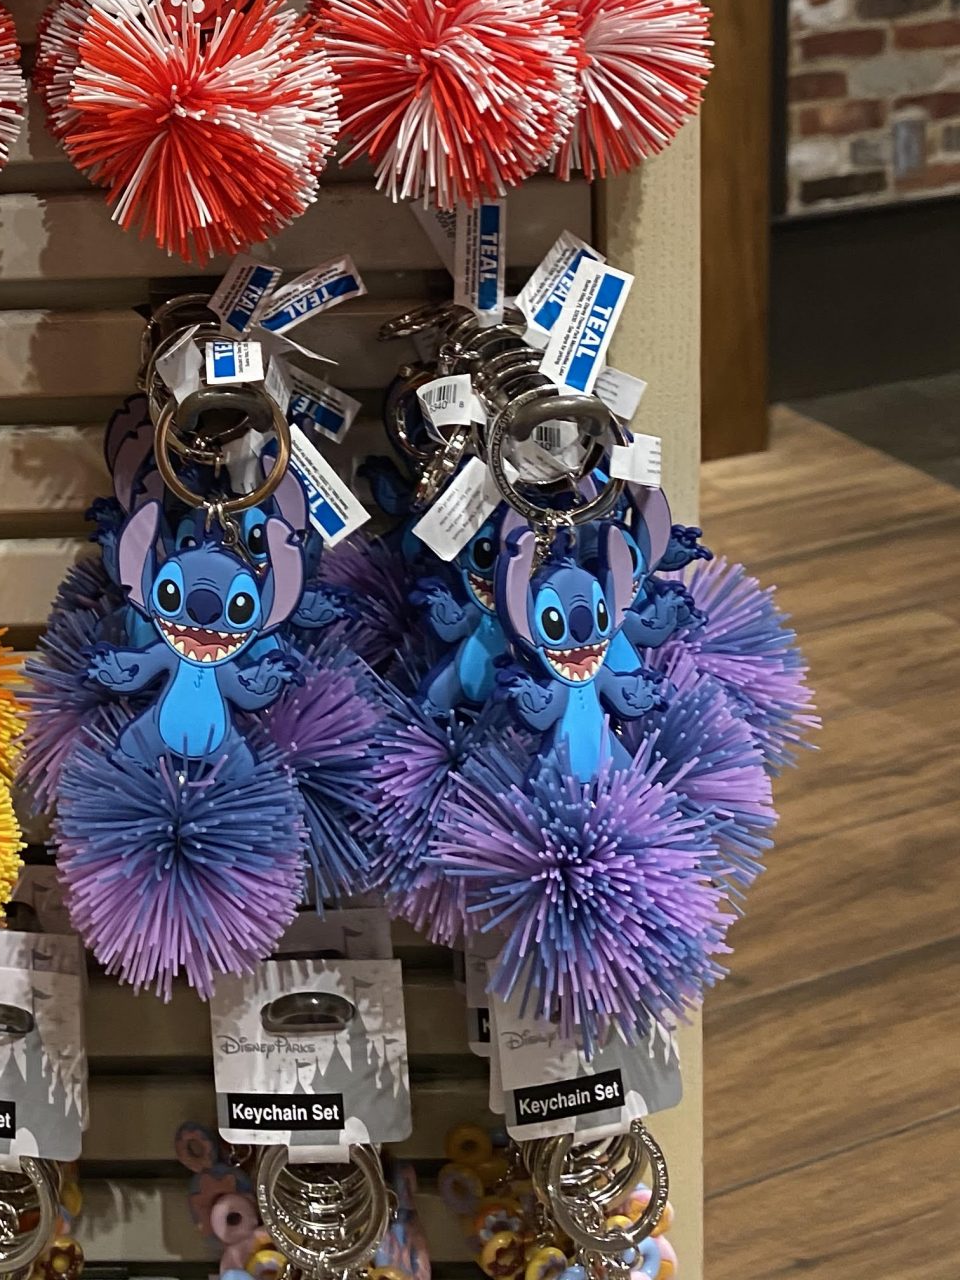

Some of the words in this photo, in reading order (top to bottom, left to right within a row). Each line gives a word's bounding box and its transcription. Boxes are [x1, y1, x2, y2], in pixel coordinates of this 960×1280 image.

[479, 232, 497, 282] TEAL
[234, 281, 264, 317] TEAL
[282, 285, 333, 321] TEAL
[575, 301, 612, 362] TEAL
[232, 1103, 307, 1124] Keychain
[312, 1104, 339, 1120] Set
[519, 1089, 590, 1116] Keychain
[595, 1081, 620, 1102] Set
